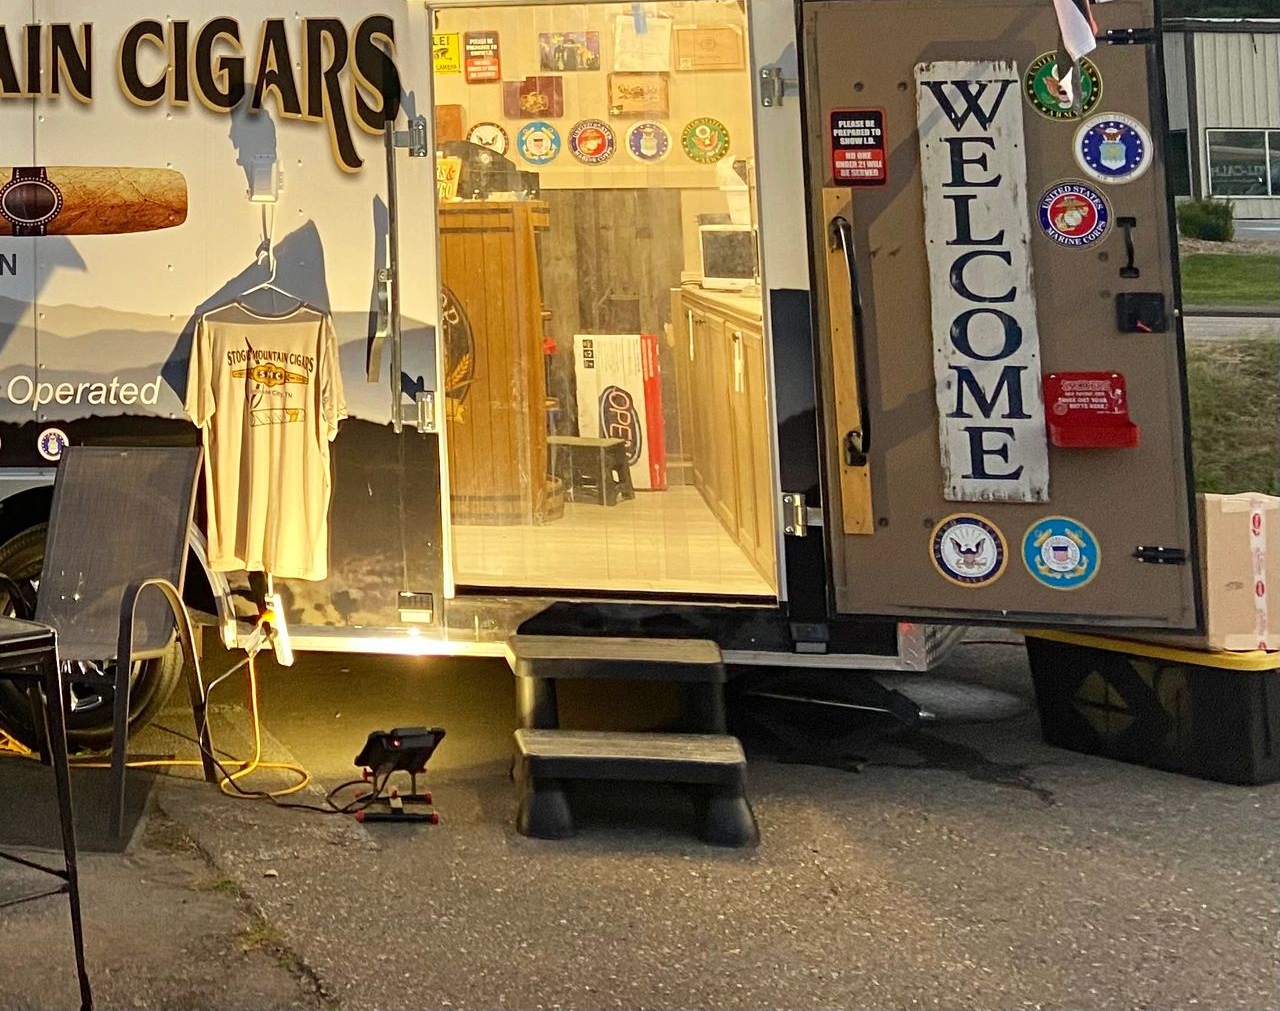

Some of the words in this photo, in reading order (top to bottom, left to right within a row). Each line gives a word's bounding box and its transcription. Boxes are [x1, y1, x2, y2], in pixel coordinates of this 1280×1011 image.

[117, 14, 401, 173] CIGARS
[833, 129, 870, 137] PREPARED
[838, 120, 864, 128] PLEASE
[840, 137, 863, 145] SHOW
[1042, 185, 1071, 210] UNITED
[1073, 185, 1103, 211] STATES
[1046, 226, 1082, 246] MARINE
[1083, 219, 1106, 244] CORPS
[919, 79, 1032, 480] WELCOME
[7, 375, 162, 411] Operated
[608, 390, 632, 458] OPE
